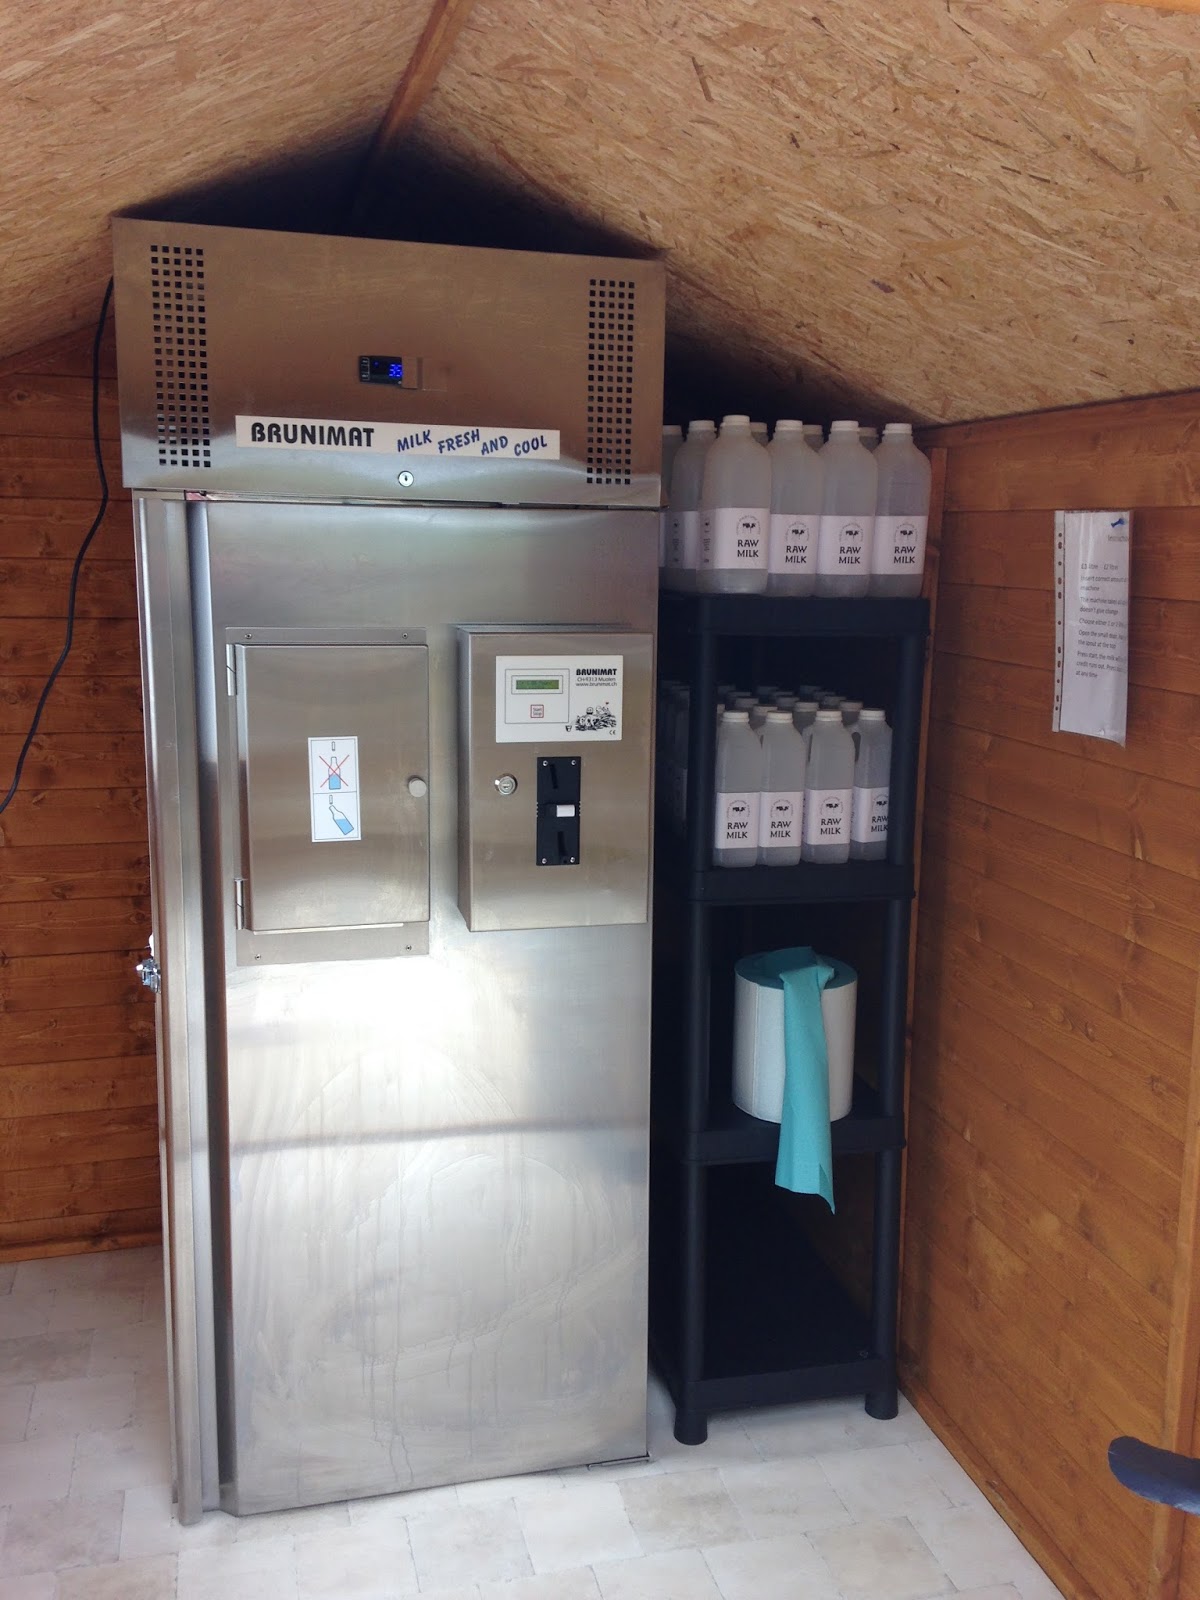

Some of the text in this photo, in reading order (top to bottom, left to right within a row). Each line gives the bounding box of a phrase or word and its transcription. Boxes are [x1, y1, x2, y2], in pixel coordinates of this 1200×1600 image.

[251, 422, 375, 448] BRUNIMAT
[397, 428, 548, 457] MILK FRESH AND COOL
[737, 539, 760, 547] RAW
[786, 545, 808, 553] RAW
[839, 546, 861, 554] RAW
[894, 546, 916, 554] RAW
[737, 549, 759, 558] MILK
[785, 555, 807, 564] MILK
[838, 556, 861, 564] MILK
[893, 556, 915, 564] MILK
[576, 668, 617, 676] BRUNIMAT
[820, 818, 842, 826] RAW
[871, 815, 888, 823] RAW
[727, 822, 748, 830] RAW
[871, 824, 888, 832] MILK
[726, 831, 748, 839] MILK
[770, 830, 791, 838] MILK
[820, 827, 841, 835] MILK
